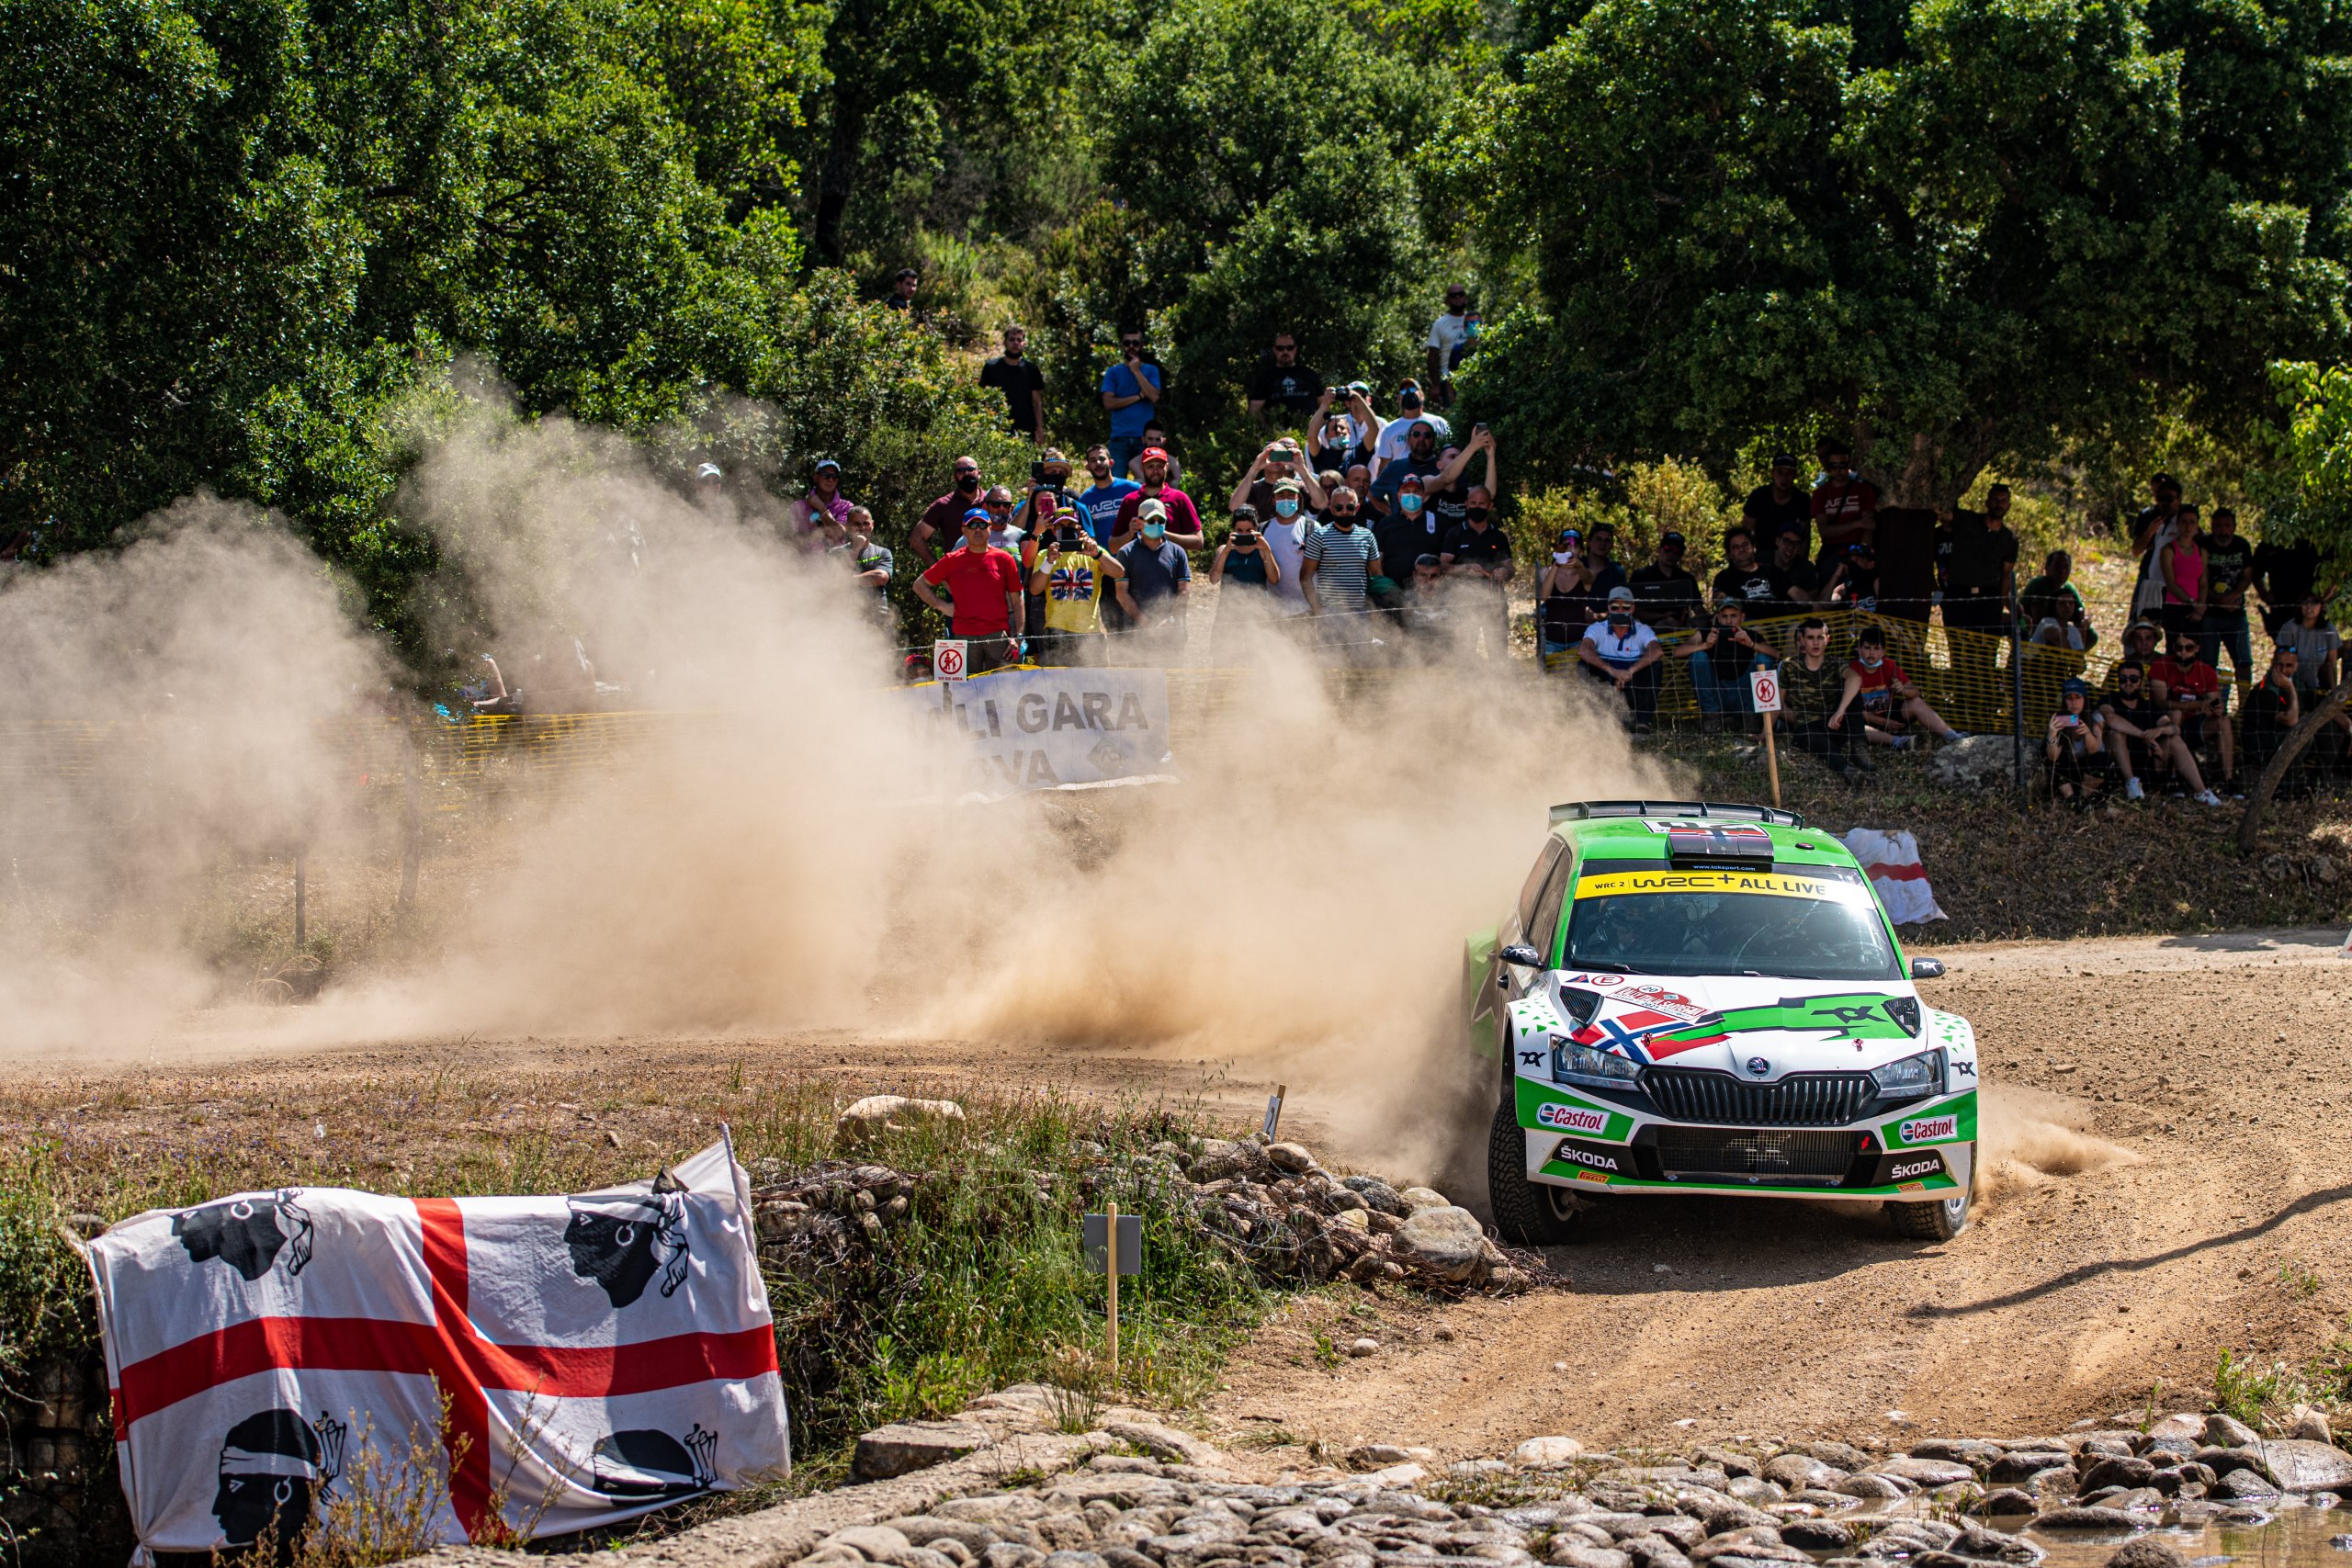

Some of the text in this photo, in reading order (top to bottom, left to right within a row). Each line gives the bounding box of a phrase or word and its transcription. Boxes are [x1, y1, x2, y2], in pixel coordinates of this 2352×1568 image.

[1015, 692, 1149, 734] GARA
[1740, 878, 1778, 890] ALL
[1783, 882, 1826, 895] LIVE
[1554, 1108, 1603, 1130] Castrol
[1914, 1119, 1953, 1139] Castrol
[1560, 1145, 1618, 1170] ŠKODA
[1892, 1159, 1940, 1179] ŠKODA
